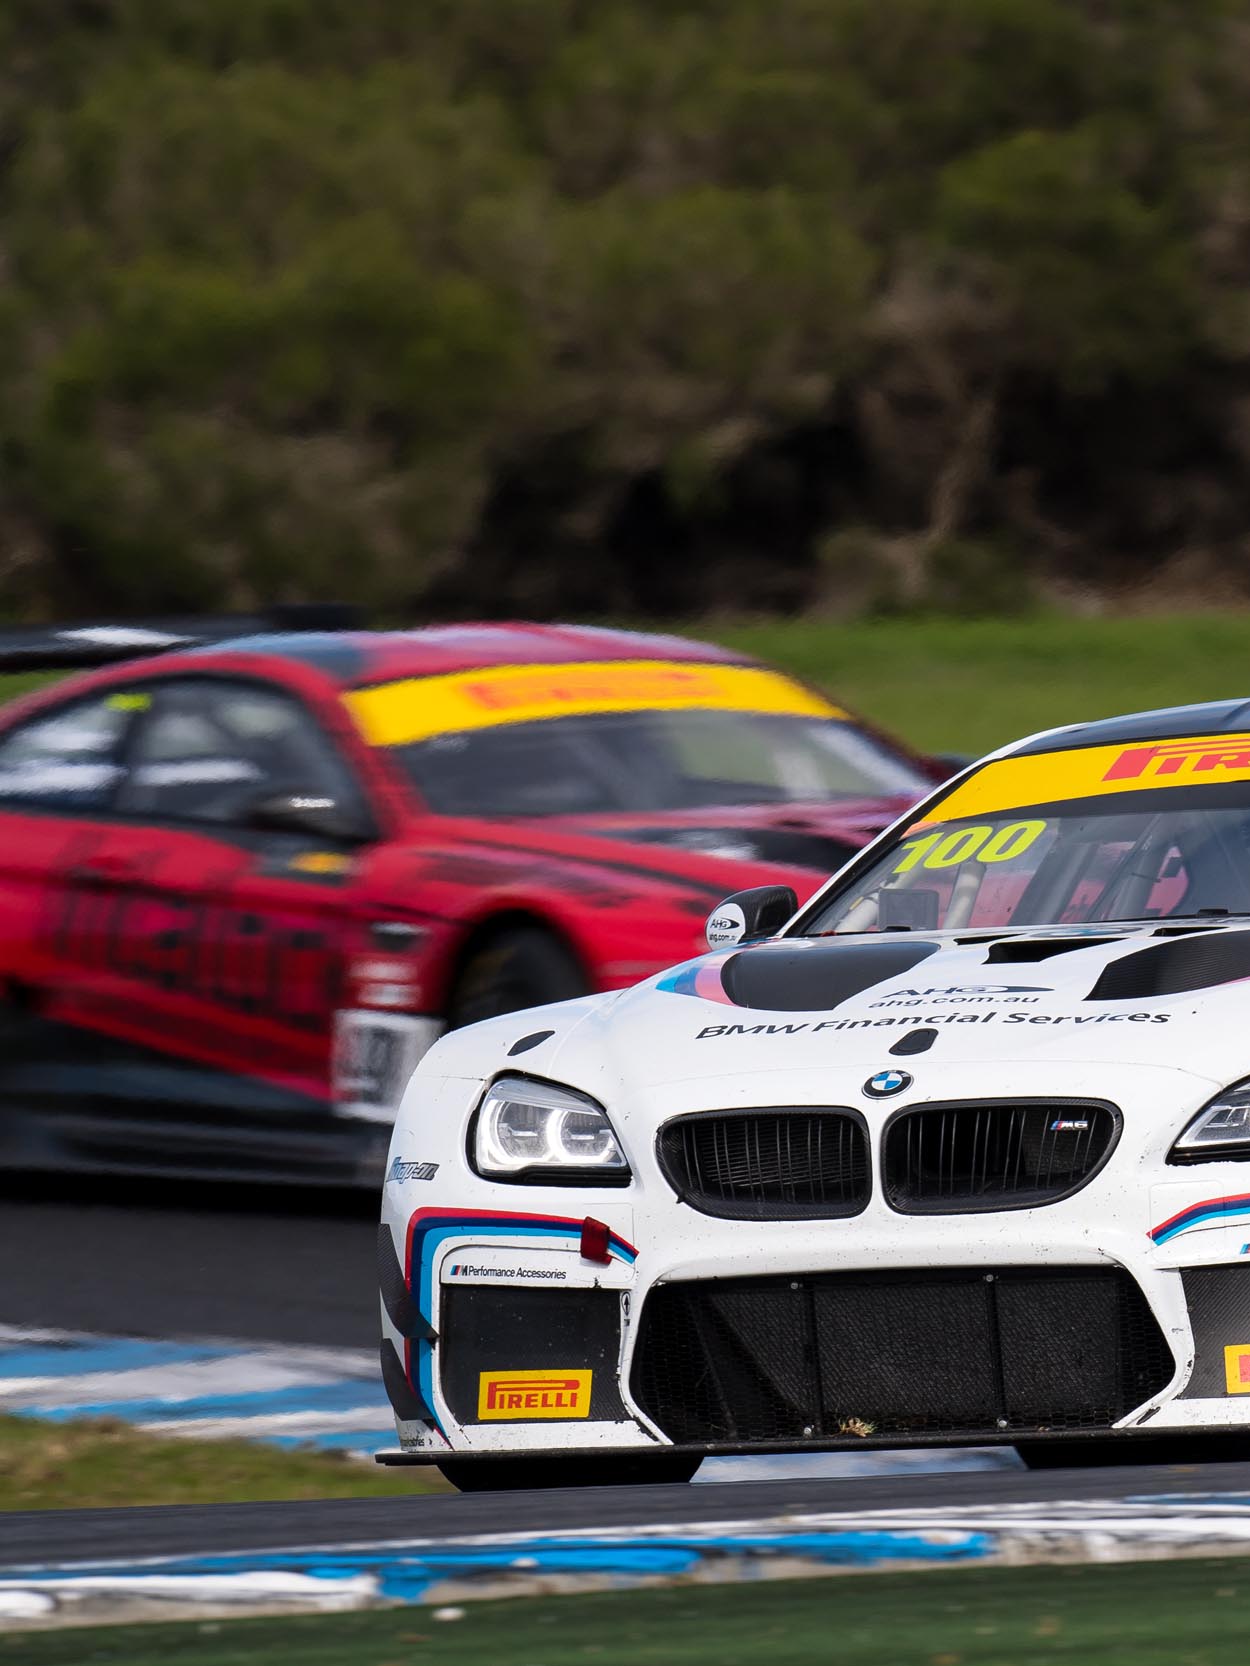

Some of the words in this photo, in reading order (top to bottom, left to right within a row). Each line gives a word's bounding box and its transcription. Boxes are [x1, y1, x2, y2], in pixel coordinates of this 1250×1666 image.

[891, 820, 1048, 875] 100
[868, 996, 1040, 1009] ahg.com.au
[695, 1023, 811, 1040] BMW
[811, 1011, 999, 1033] Financial
[1002, 1011, 1172, 1025] Services
[468, 1266, 515, 1278] Performance
[516, 1267, 567, 1280] Accessories
[486, 1379, 581, 1410] PIRELLI
